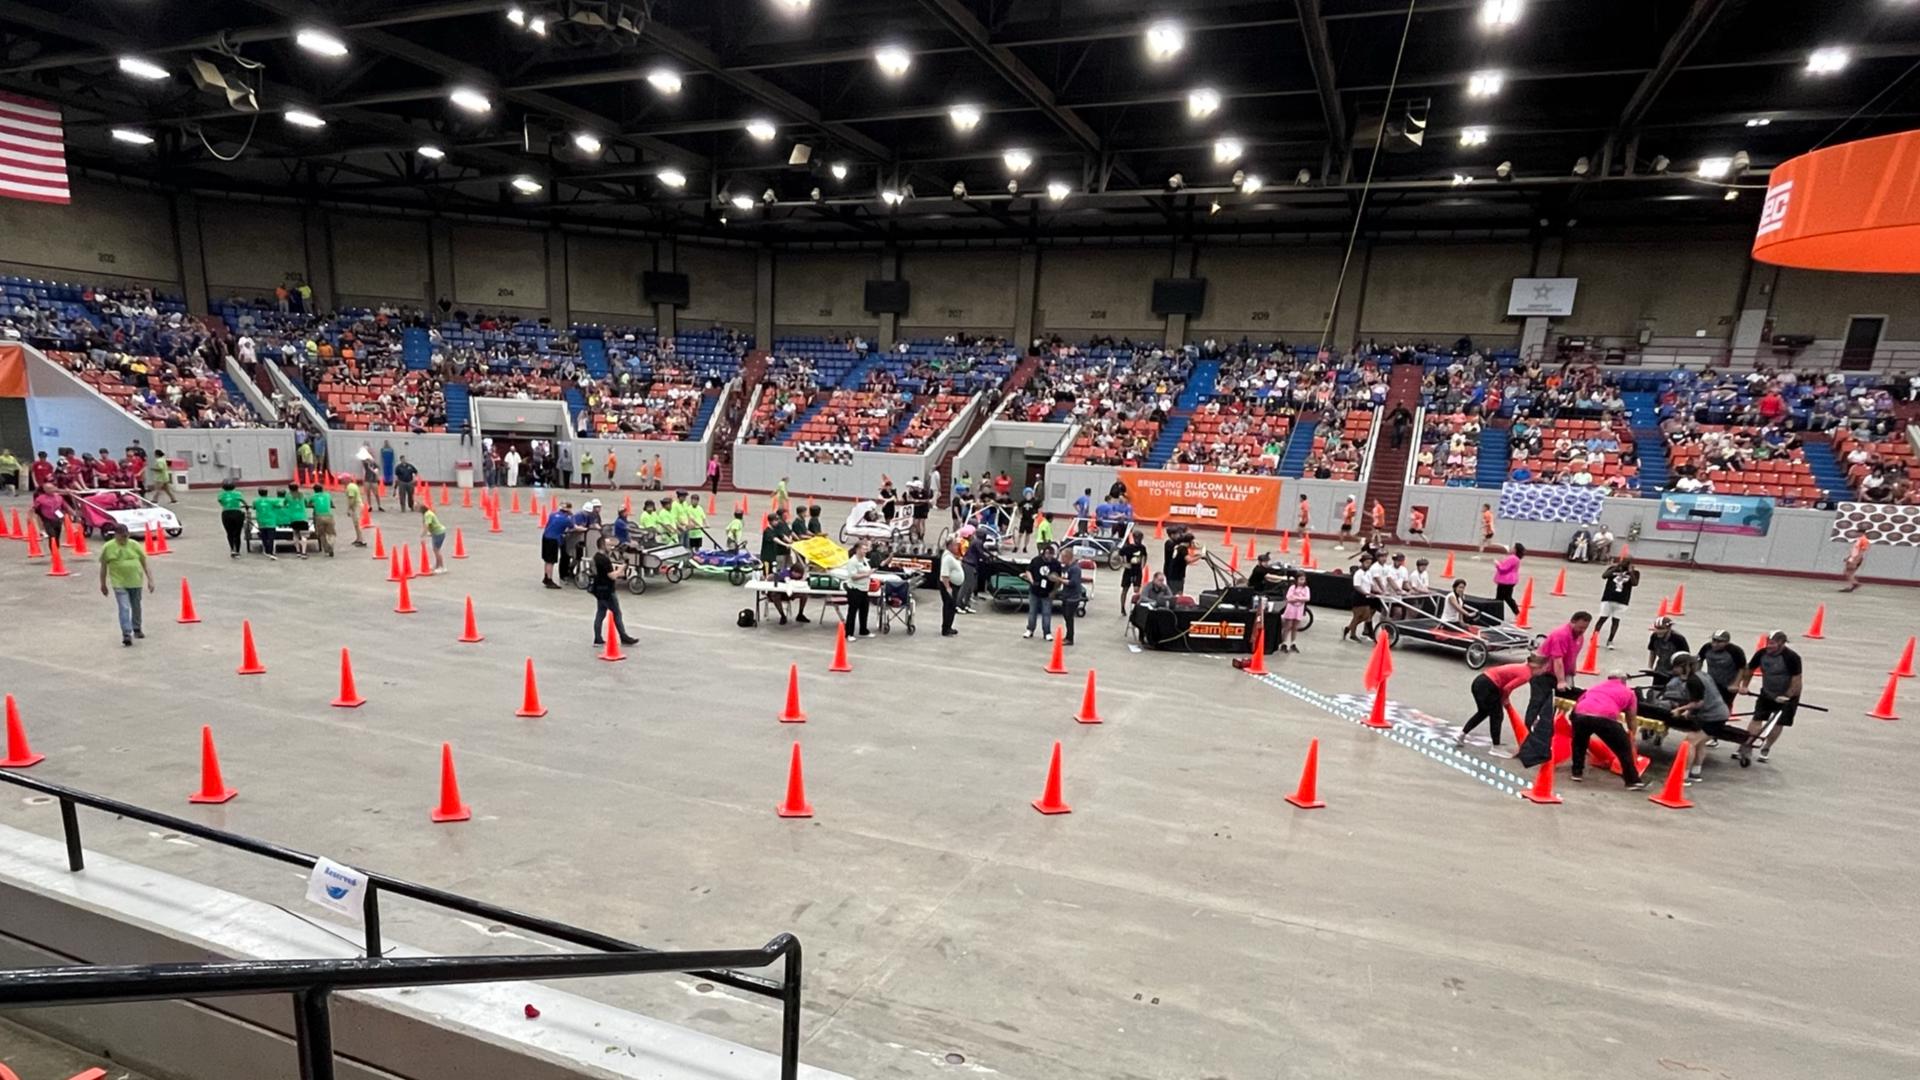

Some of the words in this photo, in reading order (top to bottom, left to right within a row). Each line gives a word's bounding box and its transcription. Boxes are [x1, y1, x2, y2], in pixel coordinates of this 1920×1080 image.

[497, 287, 515, 297] 204
[1251, 311, 1269, 320] 209
[1137, 479, 1182, 489] BRINGING
[1184, 481, 1223, 491] SILICON
[1225, 484, 1262, 494] VALLEY
[1149, 488, 1162, 497] TO
[1165, 489, 1182, 497] THE
[1184, 489, 1209, 499] OHIO
[1212, 491, 1248, 502] VALLEY
